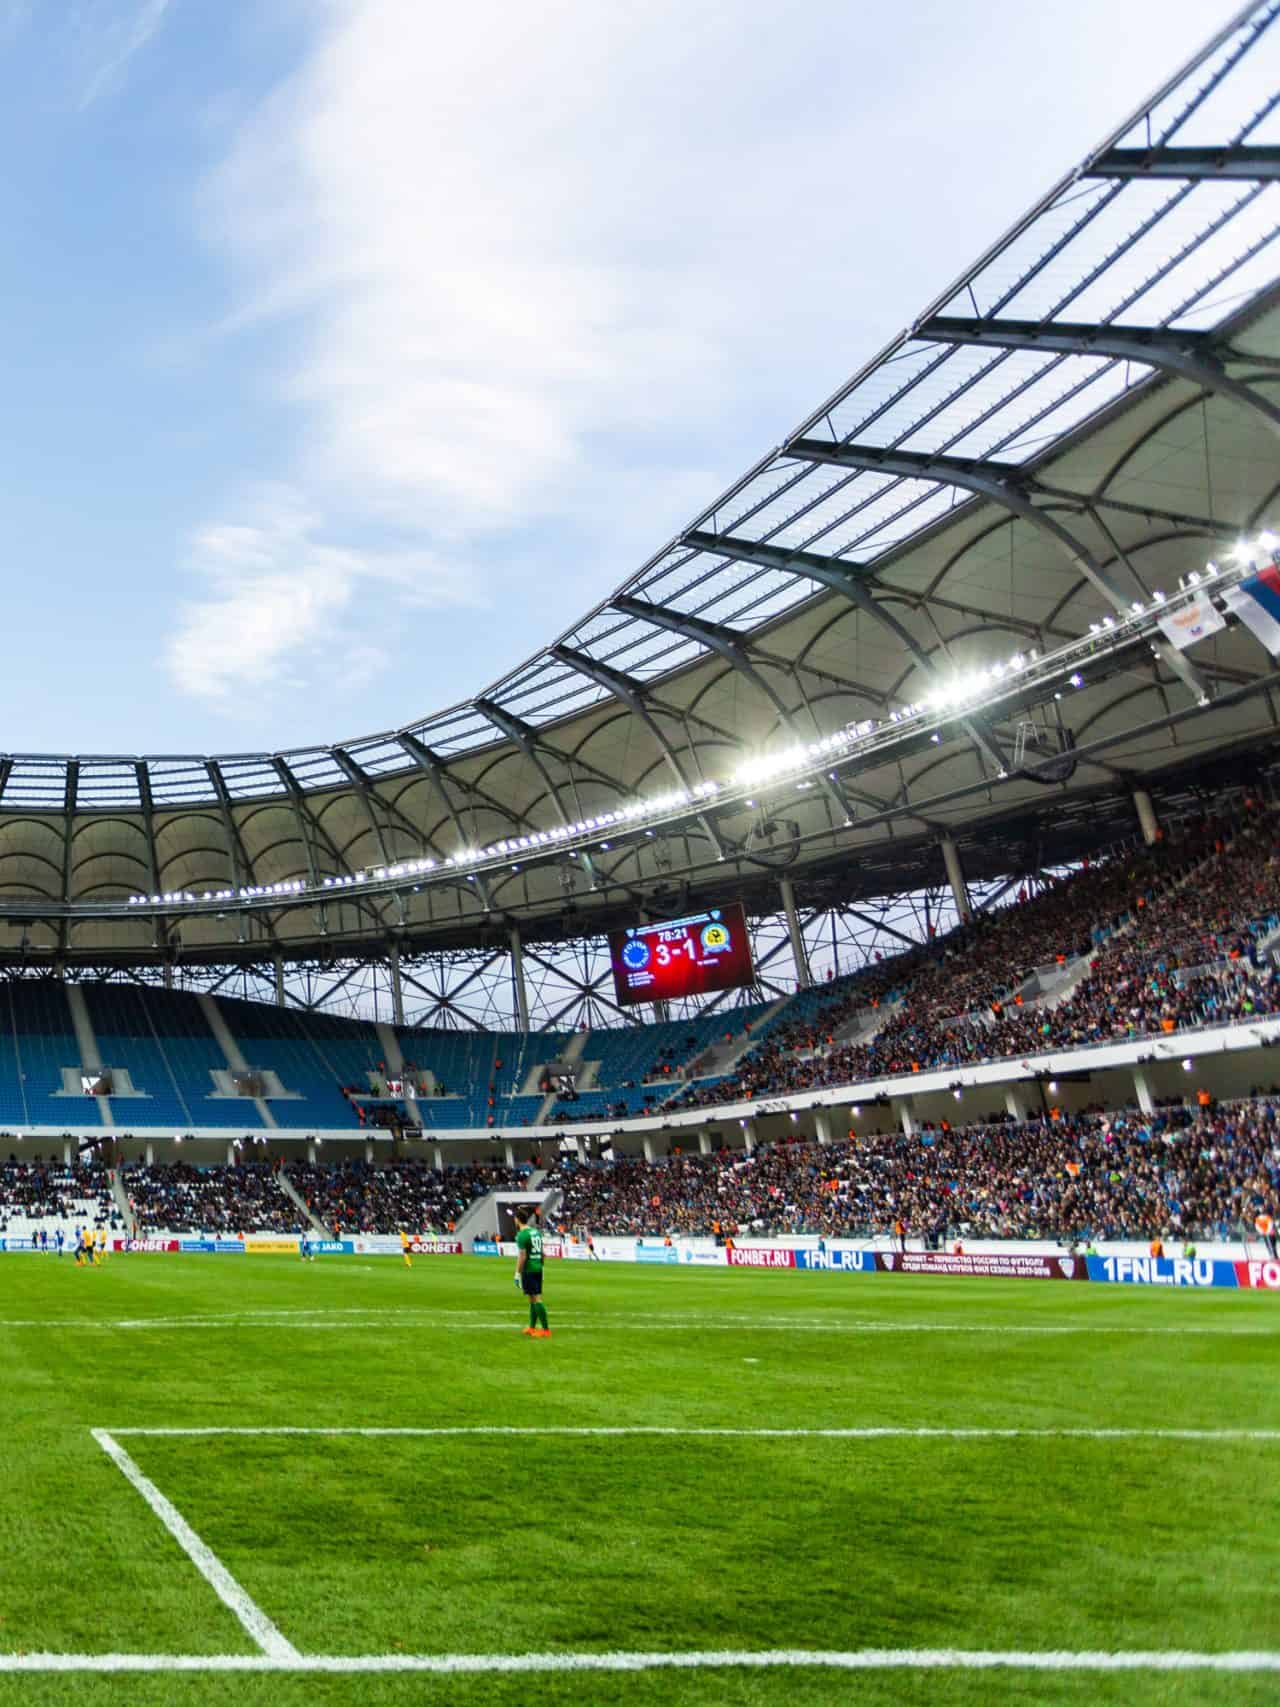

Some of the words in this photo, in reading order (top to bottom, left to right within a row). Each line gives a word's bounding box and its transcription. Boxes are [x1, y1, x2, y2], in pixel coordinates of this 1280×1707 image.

[411, 1242, 458, 1253] ФОНБЕТ
[730, 1249, 790, 1267] FONBET.RU
[804, 1251, 864, 1270] 1FNL.RU
[1104, 1258, 1214, 1285] 1FNL.RU
